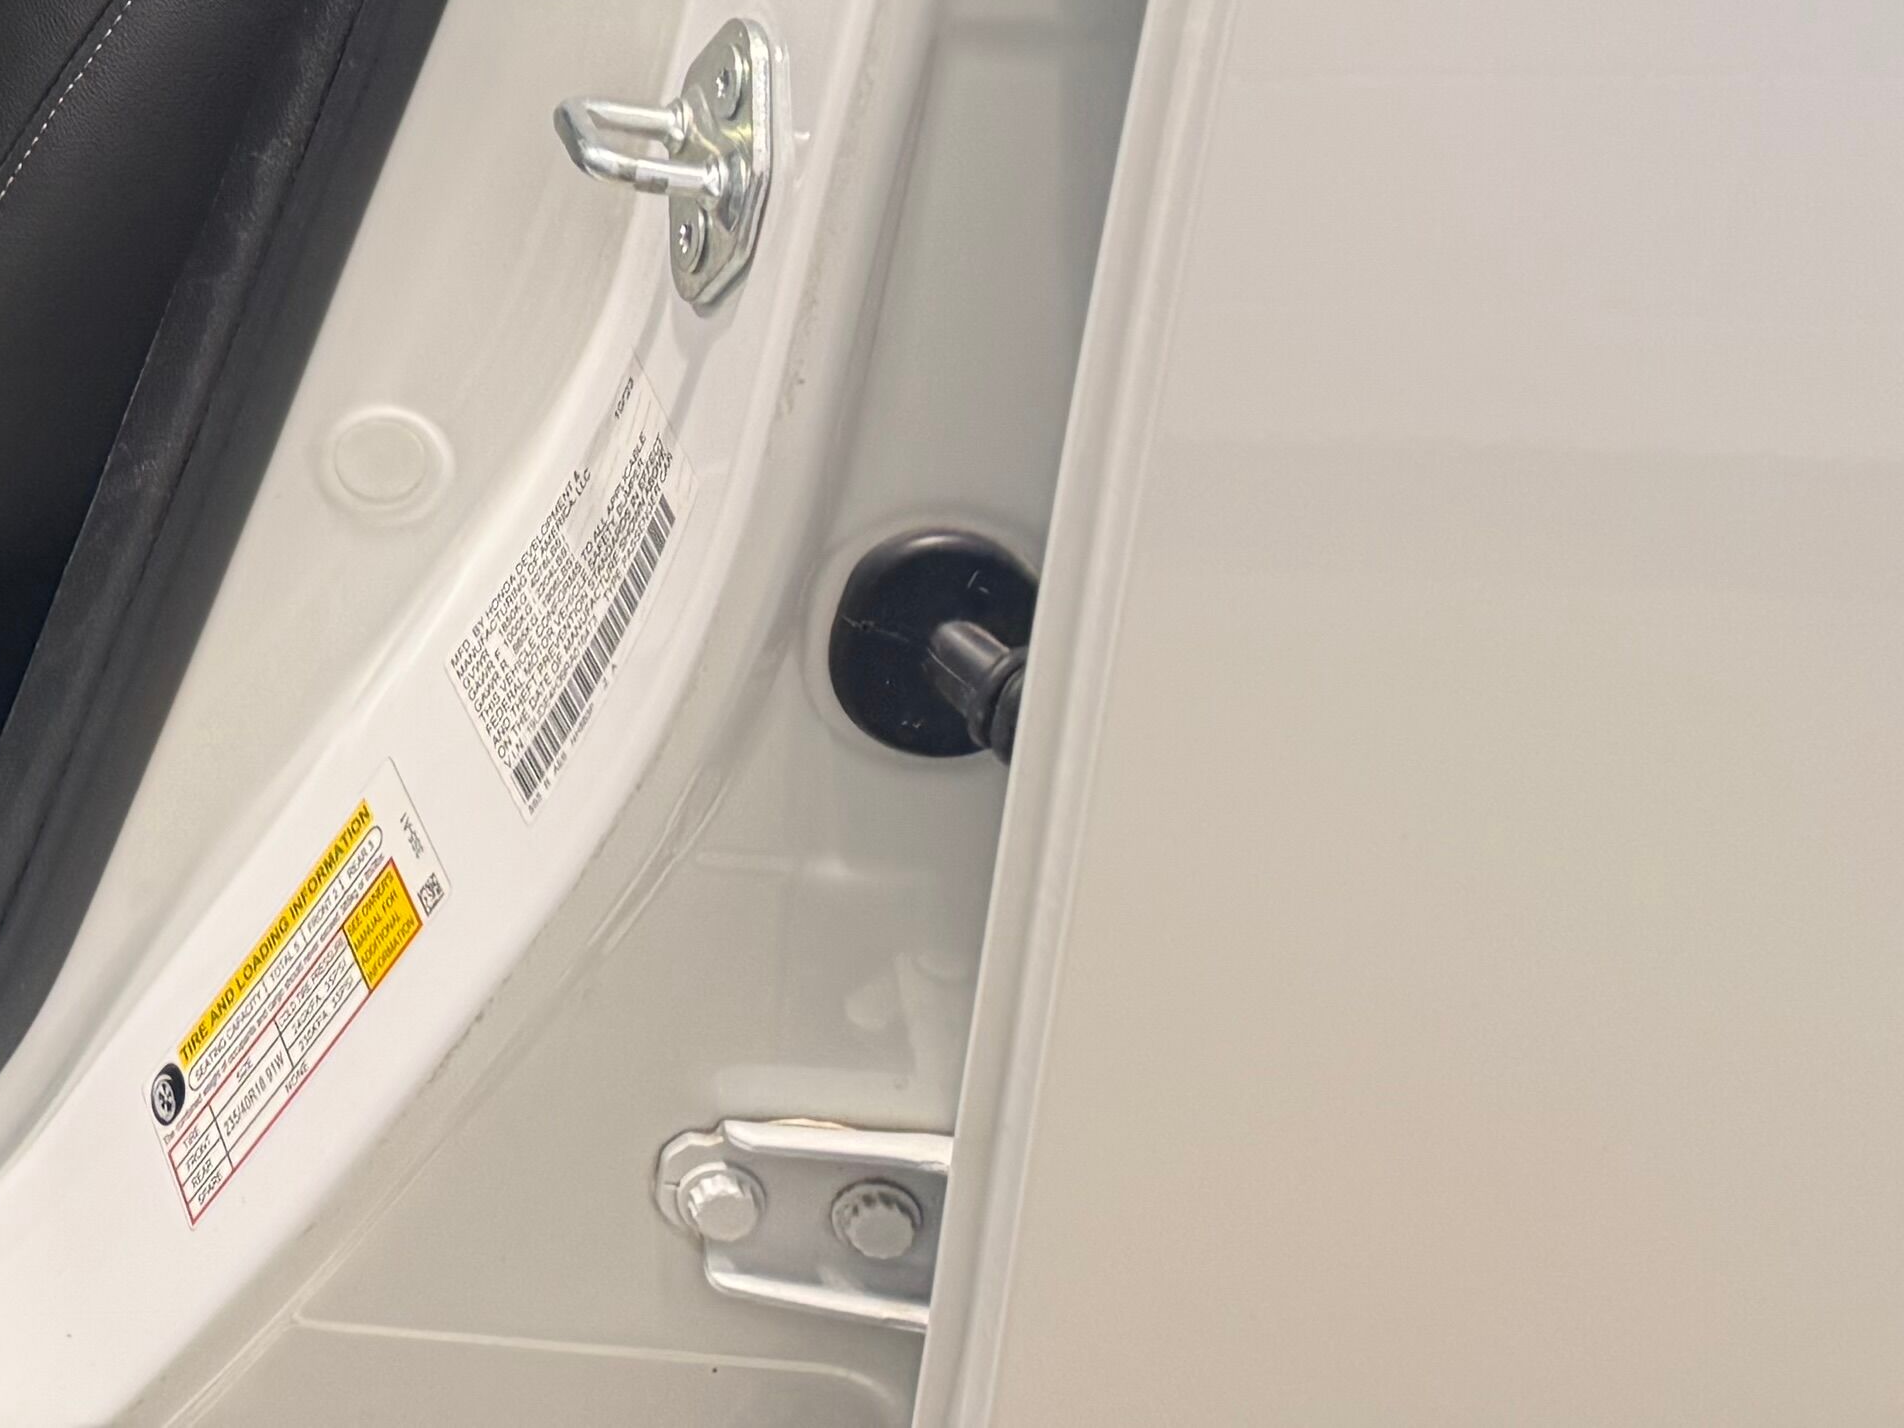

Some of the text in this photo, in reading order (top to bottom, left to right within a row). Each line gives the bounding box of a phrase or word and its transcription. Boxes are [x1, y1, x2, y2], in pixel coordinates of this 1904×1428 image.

[455, 573, 527, 680] MANUFACTURING
[526, 552, 540, 576] OF
[575, 465, 591, 497] LLC
[471, 615, 485, 638] BY
[484, 571, 516, 620] HONDA
[514, 479, 573, 576] DEVELOPMENT
[478, 430, 646, 726] THIS VEHICLE CONFORMS TO ALL APPLICABLE
[491, 715, 511, 748] AND
[509, 672, 538, 719] THEFT
[536, 588, 588, 677] PREVENTION
[587, 506, 631, 591] STANDARDS
[637, 431, 663, 492] EFFECT
[485, 675, 523, 735] FEDERAL
[523, 625, 554, 678] MOTOR
[553, 567, 589, 629] VEHICLE
[496, 732, 512, 761] ON
[510, 706, 530, 738] THE
[528, 671, 551, 712] DATE
[550, 649, 564, 675] OF
[562, 549, 620, 655] MANUFACTURE
[617, 495, 645, 553] SHOWN
[179, 803, 370, 1064] TIRE AND LOADING INFORMATION
[346, 869, 394, 937] SEE OWNER'S
[352, 888, 398, 952] MANUAL FOR
[194, 1035, 226, 1081] SEATING
[225, 988, 262, 1041] CAPACITY
[269, 948, 293, 983] TOTAL
[306, 894, 333, 933] FRONT
[345, 846, 368, 880] REAR
[359, 909, 401, 967] ADDITIONAL
[365, 913, 415, 982] INFORMATION
[296, 979, 311, 1003] TIRE
[222, 1049, 285, 1138] 235/40R18 91W
[284, 1058, 309, 1095] NONE
[163, 1126, 175, 1147] The
[183, 1124, 199, 1151] TIRE
[185, 1133, 212, 1172] FRONT
[191, 1156, 213, 1190] REAR
[197, 1167, 223, 1206] SPARE
